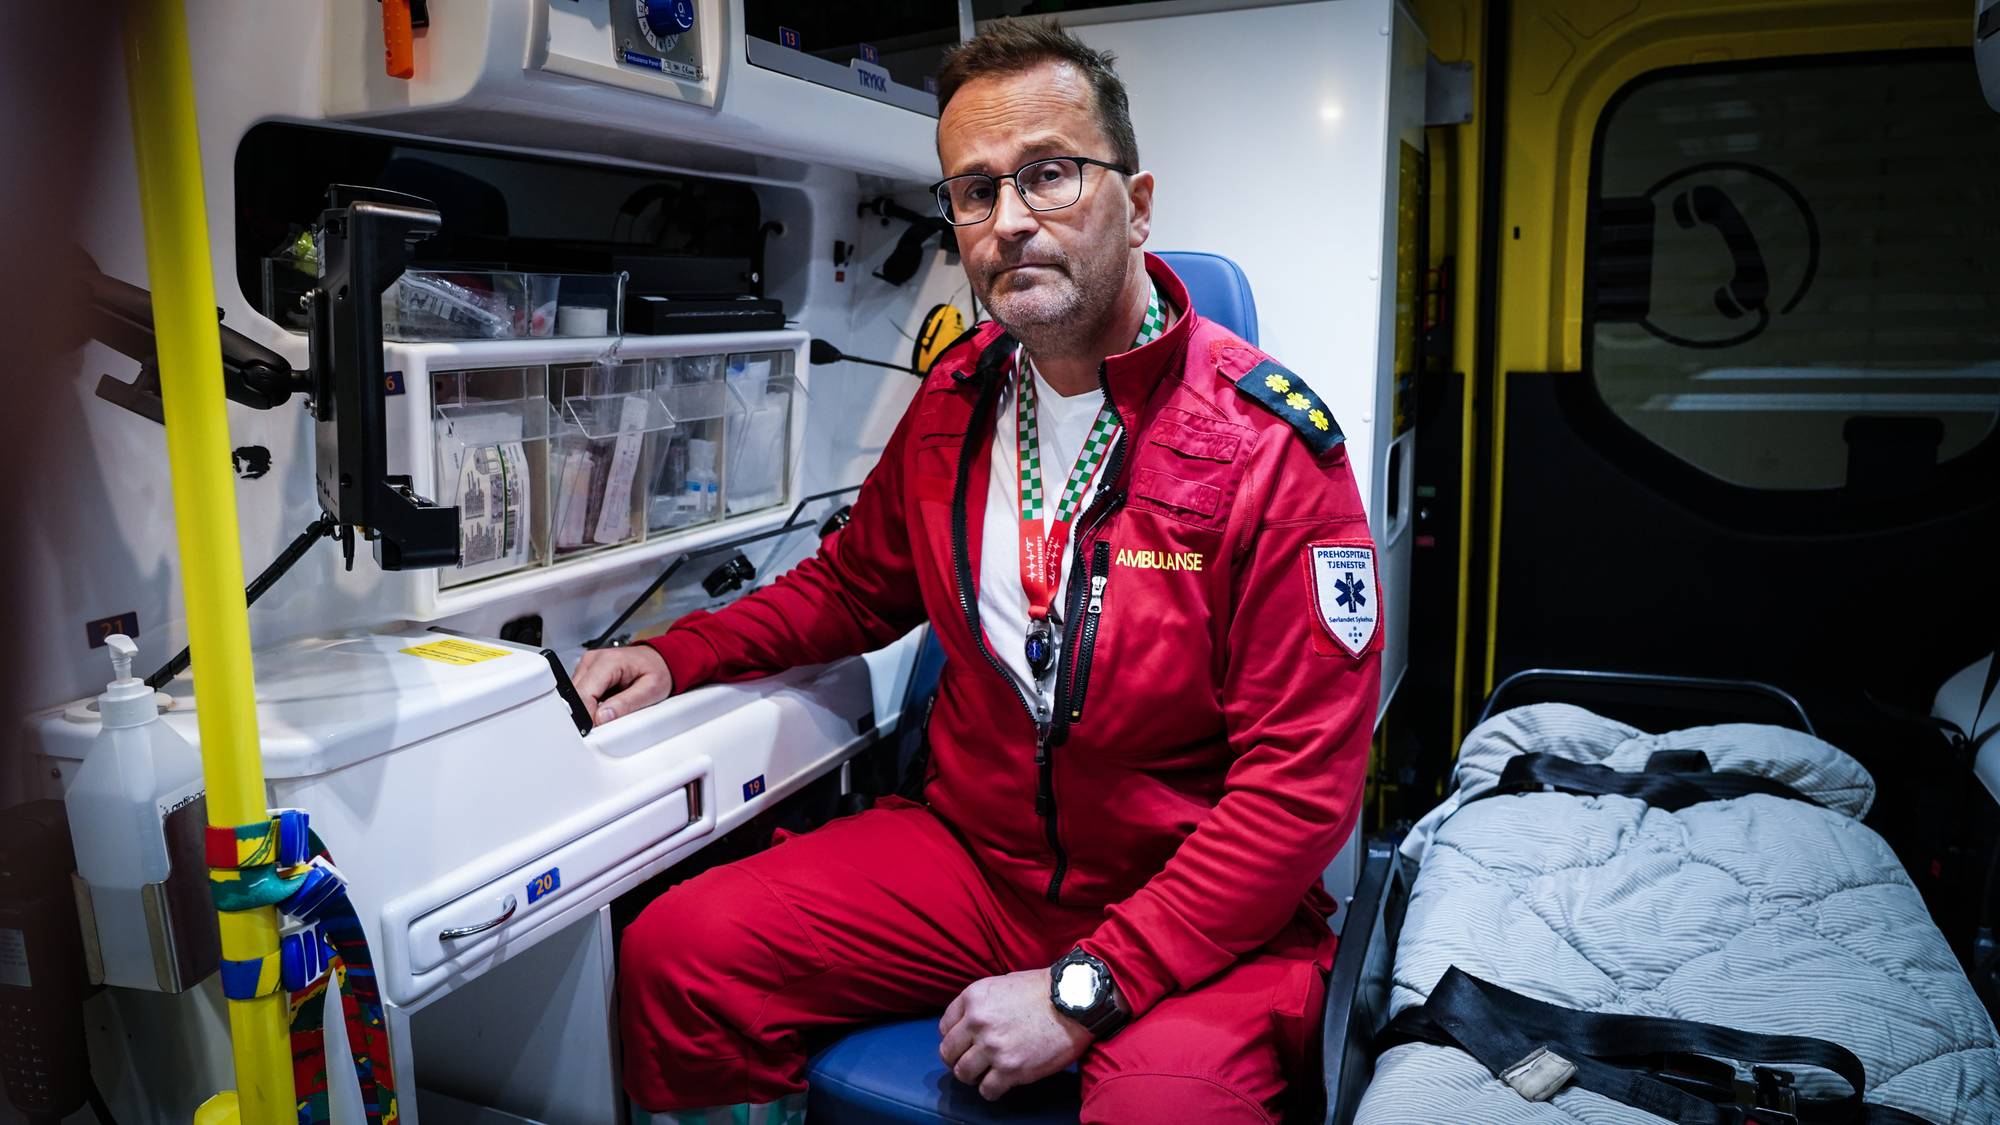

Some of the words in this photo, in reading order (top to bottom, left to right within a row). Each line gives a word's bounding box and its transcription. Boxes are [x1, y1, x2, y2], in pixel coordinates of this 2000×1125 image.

[785, 31, 796, 46] 13
[865, 47, 874, 61] 14
[857, 68, 887, 93] TRYKK
[384, 375, 396, 391] 6
[1115, 548, 1204, 572] AMBULANSE
[1317, 550, 1371, 560] PREHOSPITALE
[1327, 561, 1367, 569] TJENESTER
[1328, 616, 1355, 624] Sørlandet
[749, 779, 761, 794] 19
[535, 874, 553, 896] 20
